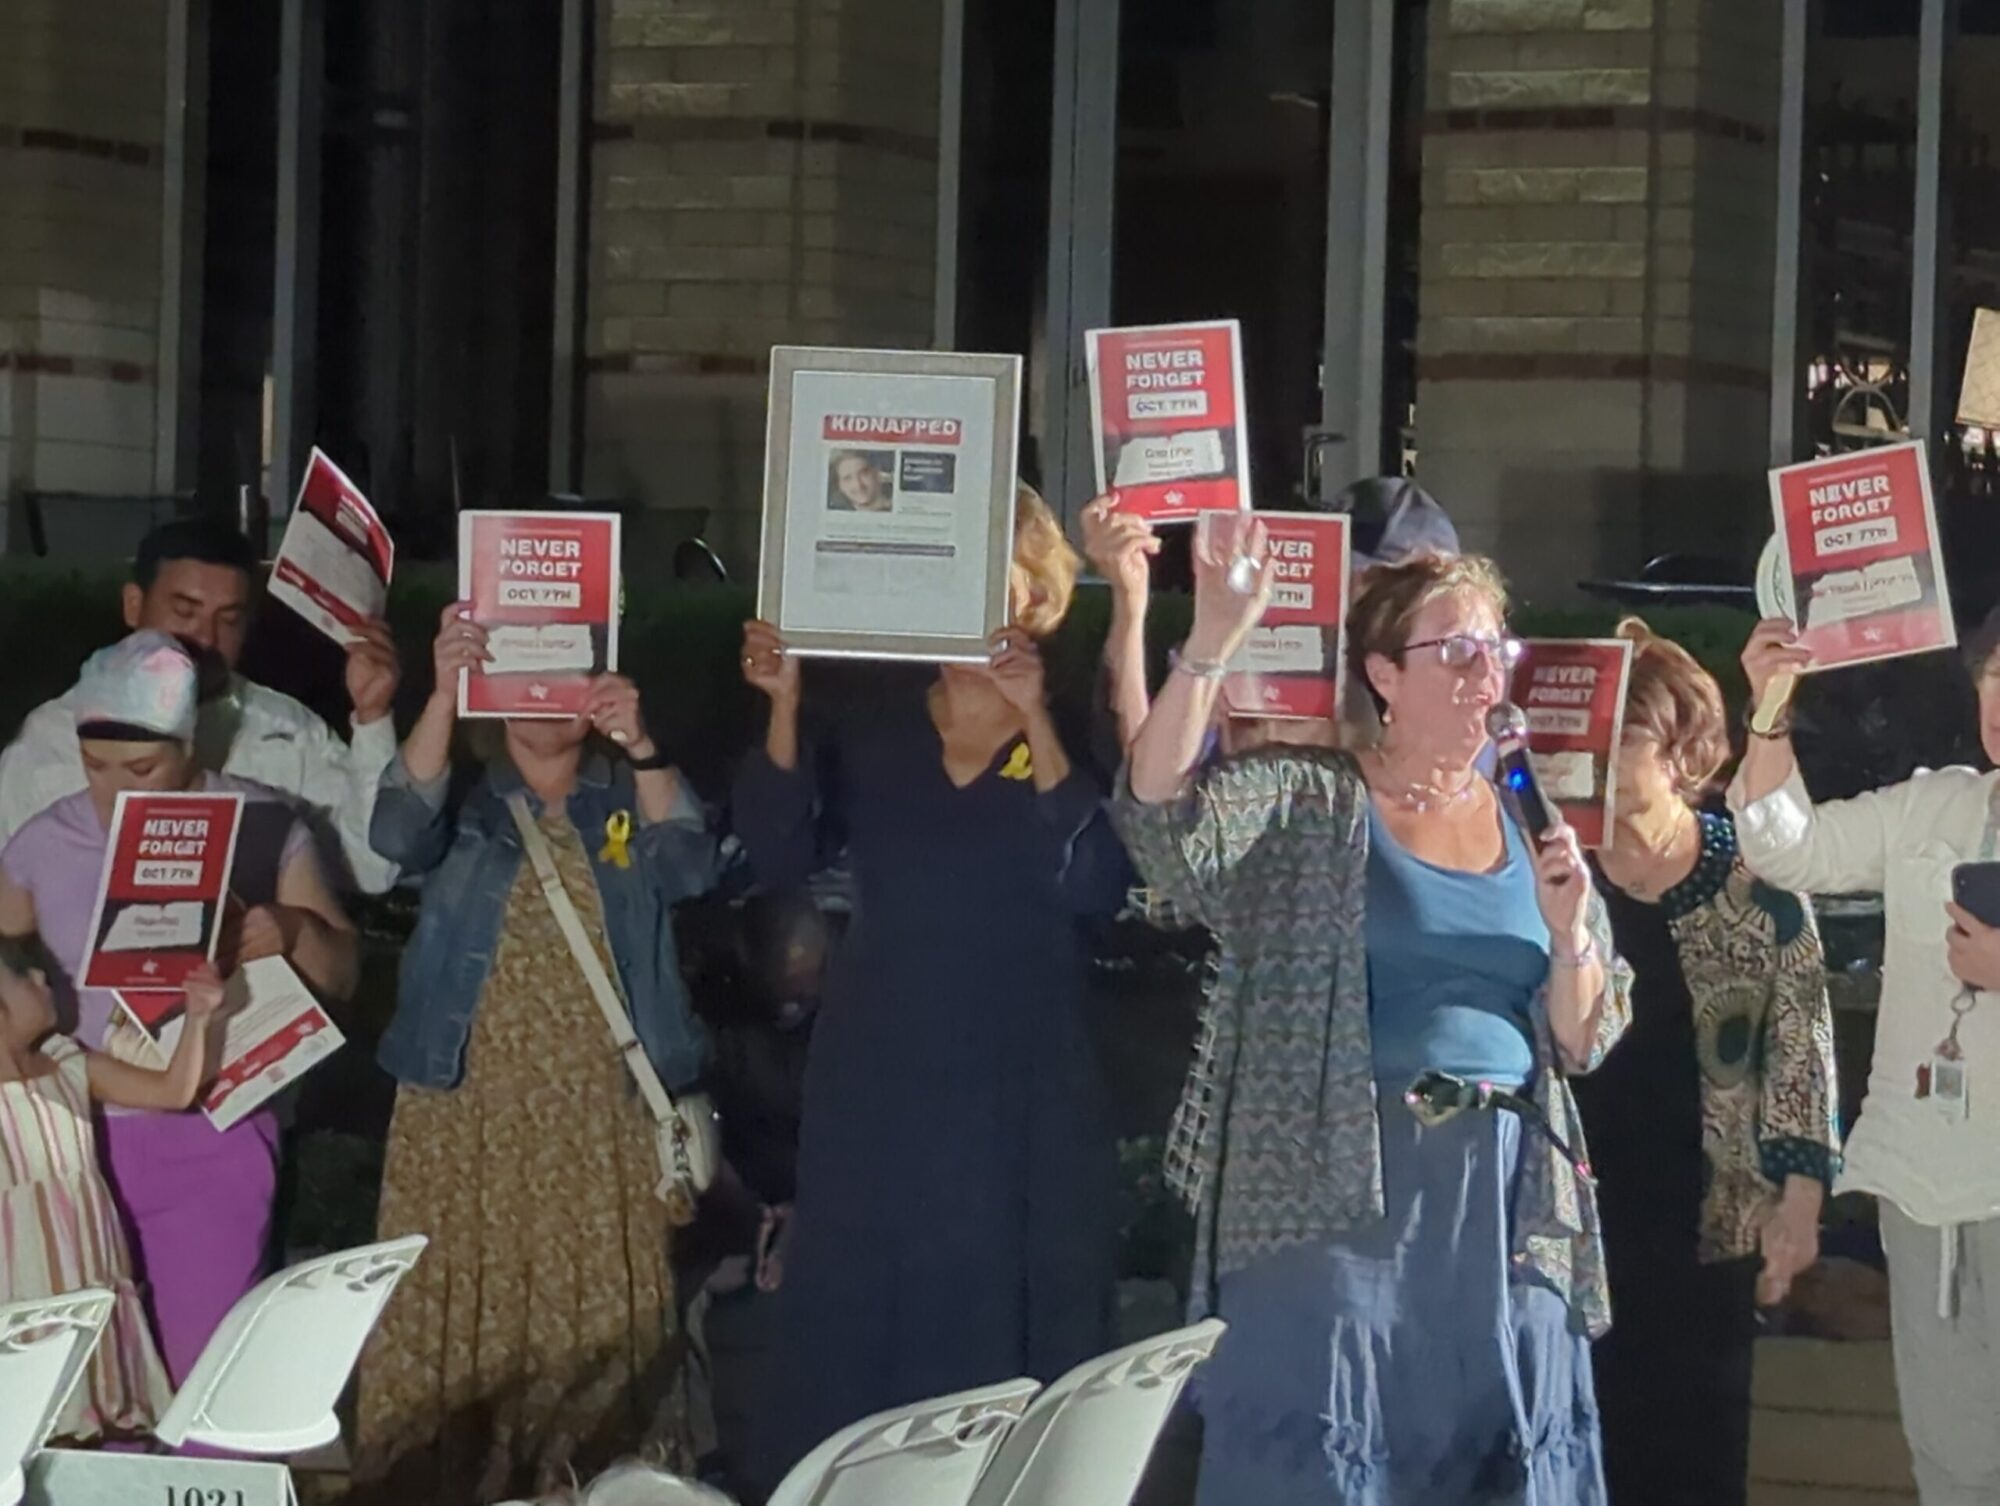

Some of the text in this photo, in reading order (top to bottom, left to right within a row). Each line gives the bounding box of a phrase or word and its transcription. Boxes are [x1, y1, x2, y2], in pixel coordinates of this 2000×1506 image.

[1126, 350, 1203, 370] NEVER
[1126, 370, 1207, 389] FORGET
[1136, 399, 1198, 412] OCT 7TH
[831, 416, 957, 435] KIDNAPPED
[1809, 475, 1890, 506] NEVER
[1811, 496, 1892, 525] FORGET
[500, 539, 580, 557] NEVER
[1269, 539, 1314, 558] VER
[1824, 534, 1853, 548] OCT
[500, 561, 582, 577] FORGET
[507, 588, 571, 602] OCT 7TH
[1533, 665, 1597, 684] NEVER
[1528, 687, 1594, 702] FORGET
[143, 819, 209, 837] NEVER
[139, 840, 207, 855] FORGET
[141, 867, 194, 879] OCT 7TH
